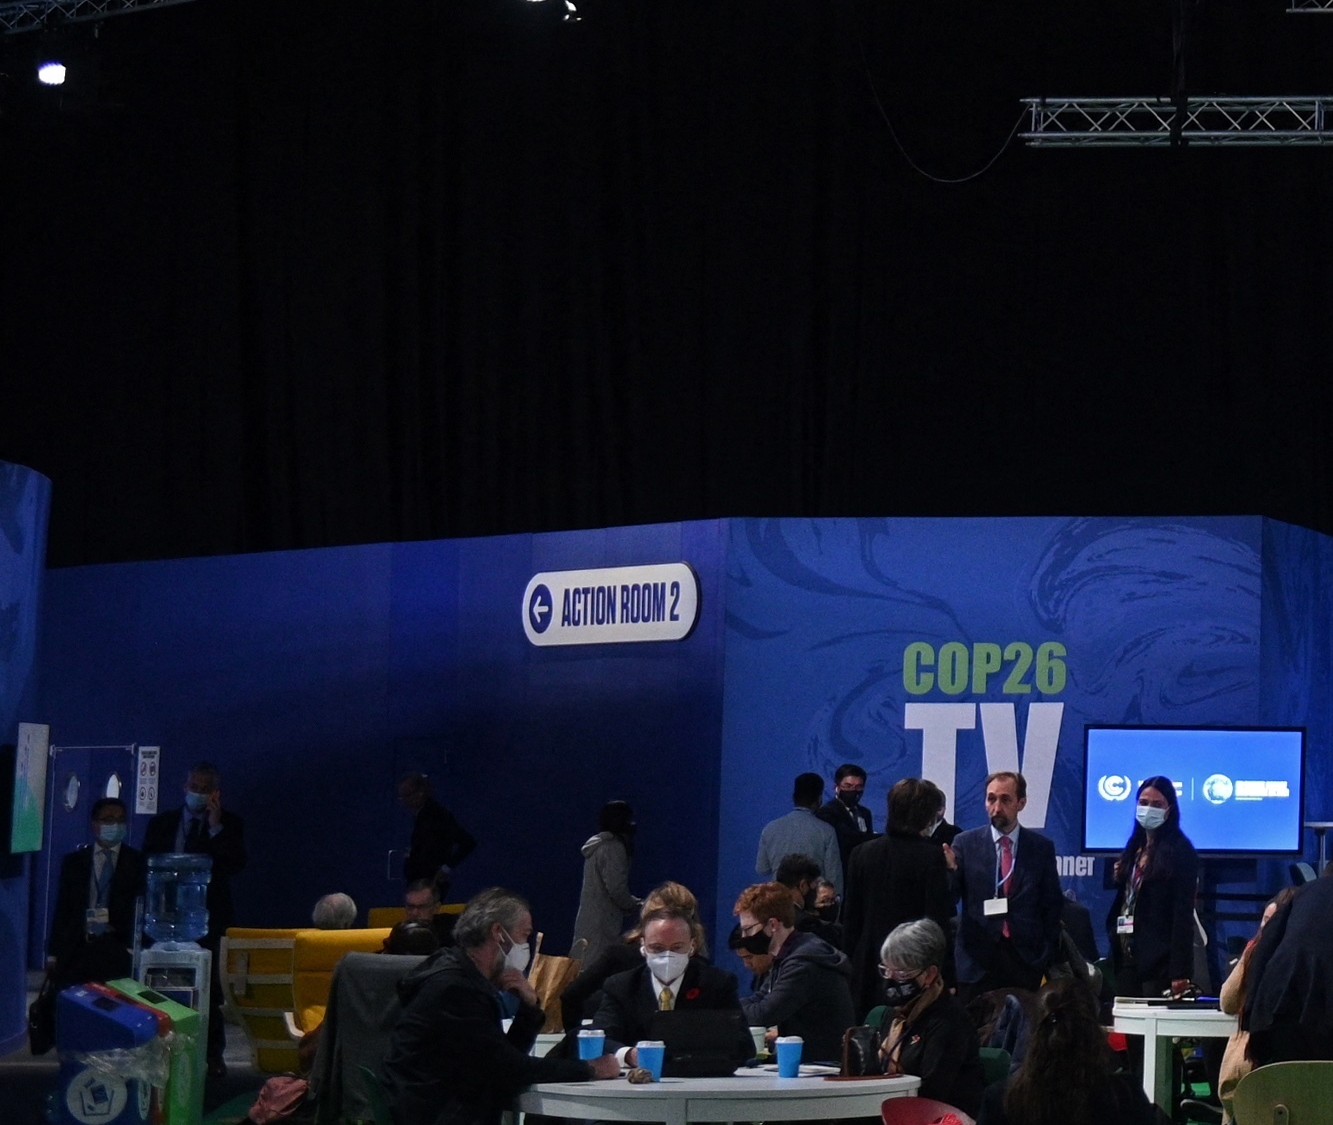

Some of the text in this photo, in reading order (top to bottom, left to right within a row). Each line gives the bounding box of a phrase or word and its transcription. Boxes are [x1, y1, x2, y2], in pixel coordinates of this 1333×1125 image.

[561, 581, 681, 627] ACTION ROOM 2
[903, 641, 1067, 695] COP26
[904, 702, 1065, 829] TV
